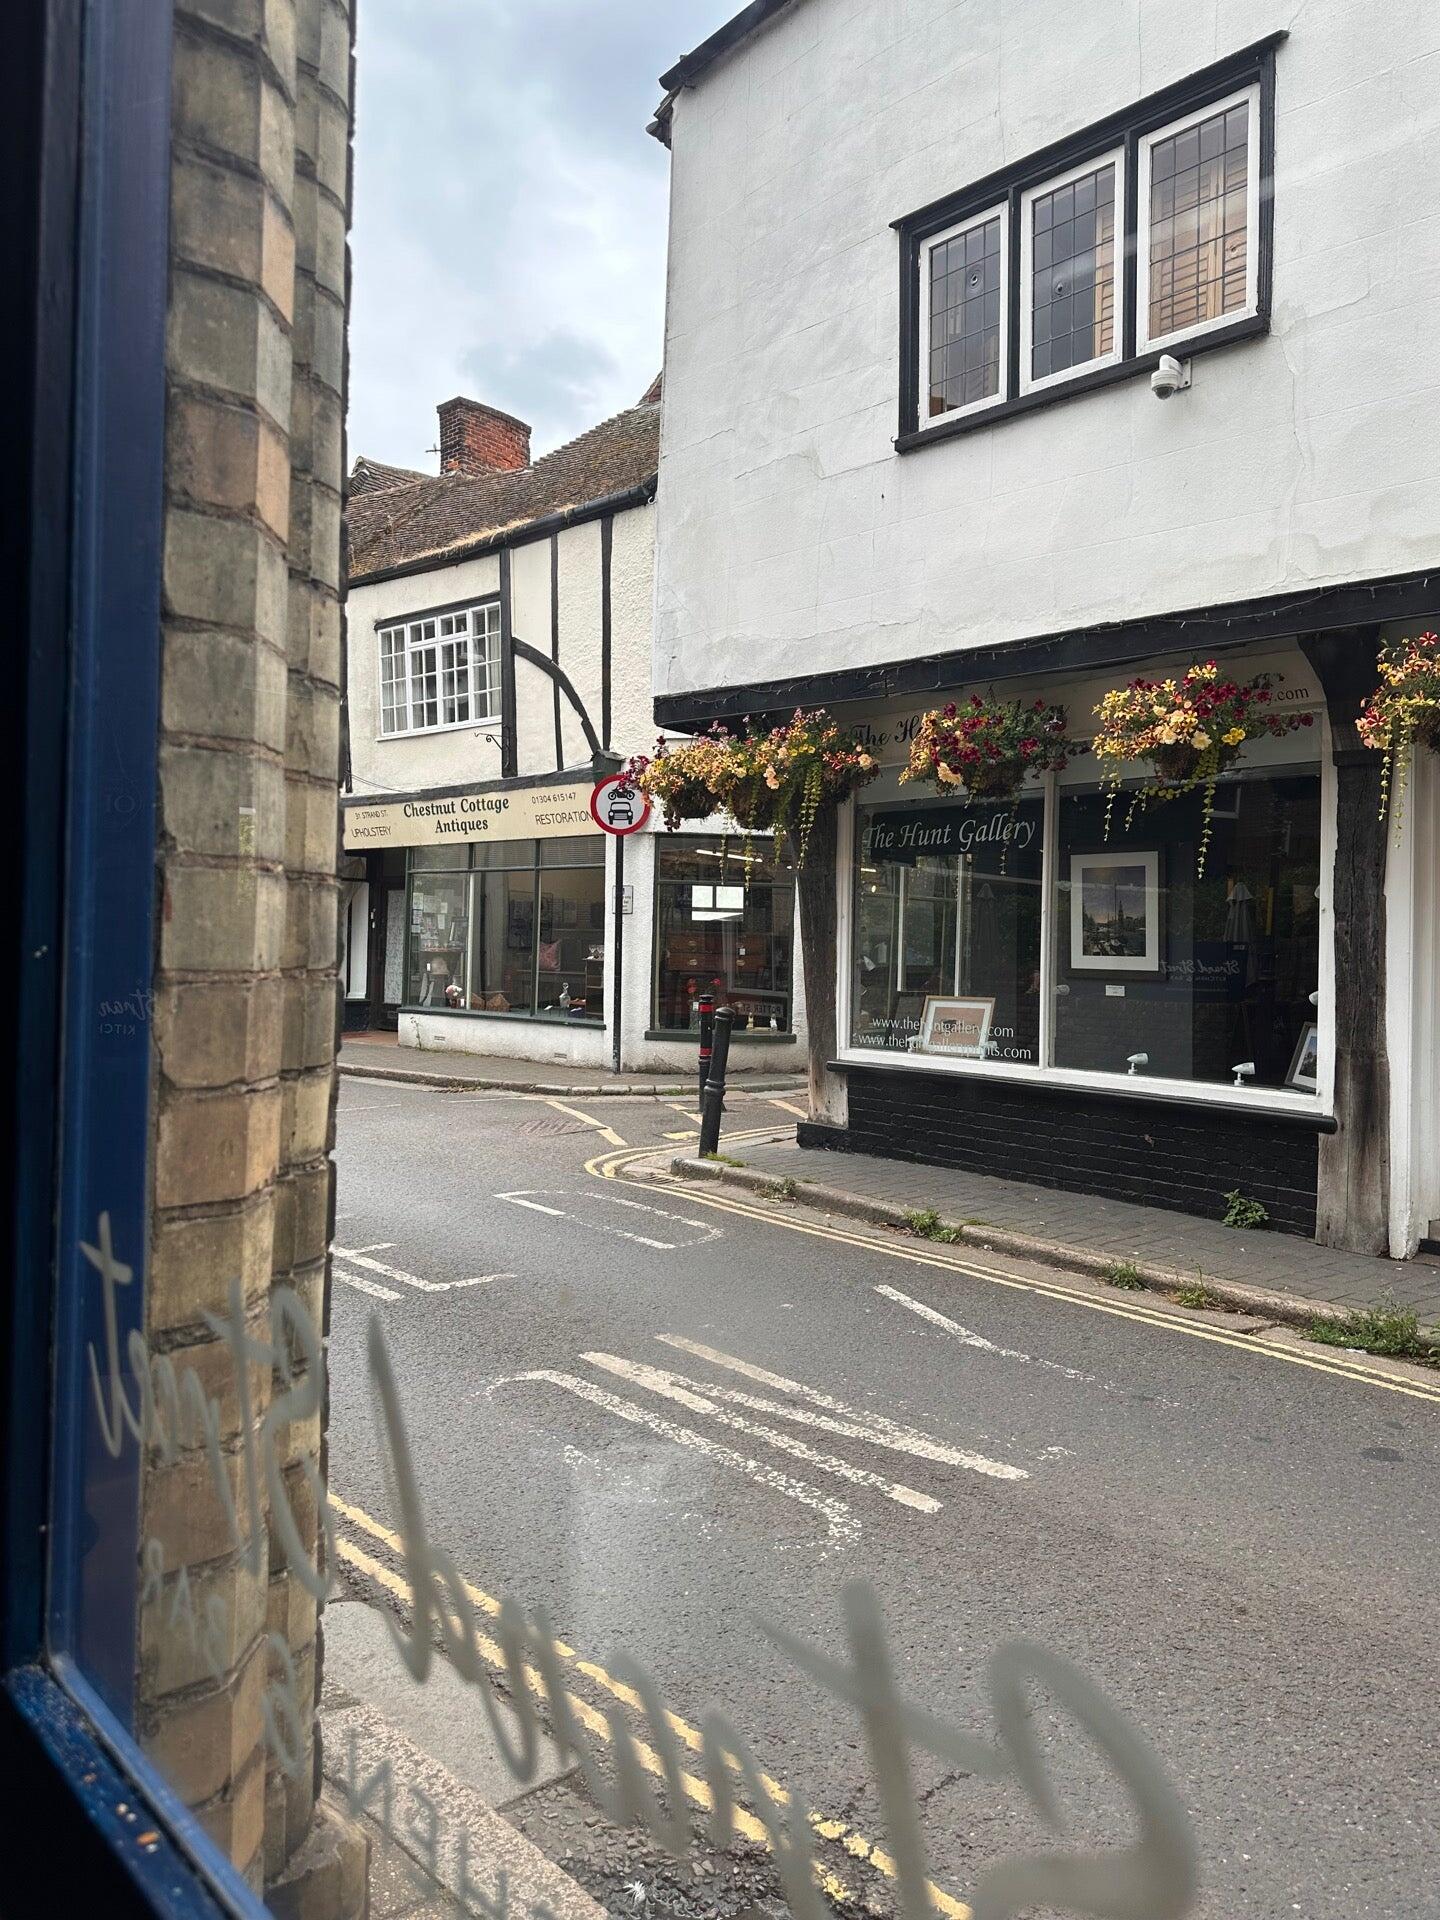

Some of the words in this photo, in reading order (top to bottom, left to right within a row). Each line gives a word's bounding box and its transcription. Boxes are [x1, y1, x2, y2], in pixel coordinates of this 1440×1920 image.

[531, 794, 552, 805] 01304
[552, 791, 577, 803] 615147
[361, 810, 381, 820] STRAND
[403, 801, 457, 818] Chestnut
[460, 798, 510, 814] Cottage
[534, 810, 595, 826] RESTORATION
[351, 825, 392, 838] UPHOLSTERY
[435, 819, 489, 835] Antiques
[862, 822, 895, 849] The
[899, 821, 952, 848] Hunt
[958, 812, 1036, 852] Gallery
